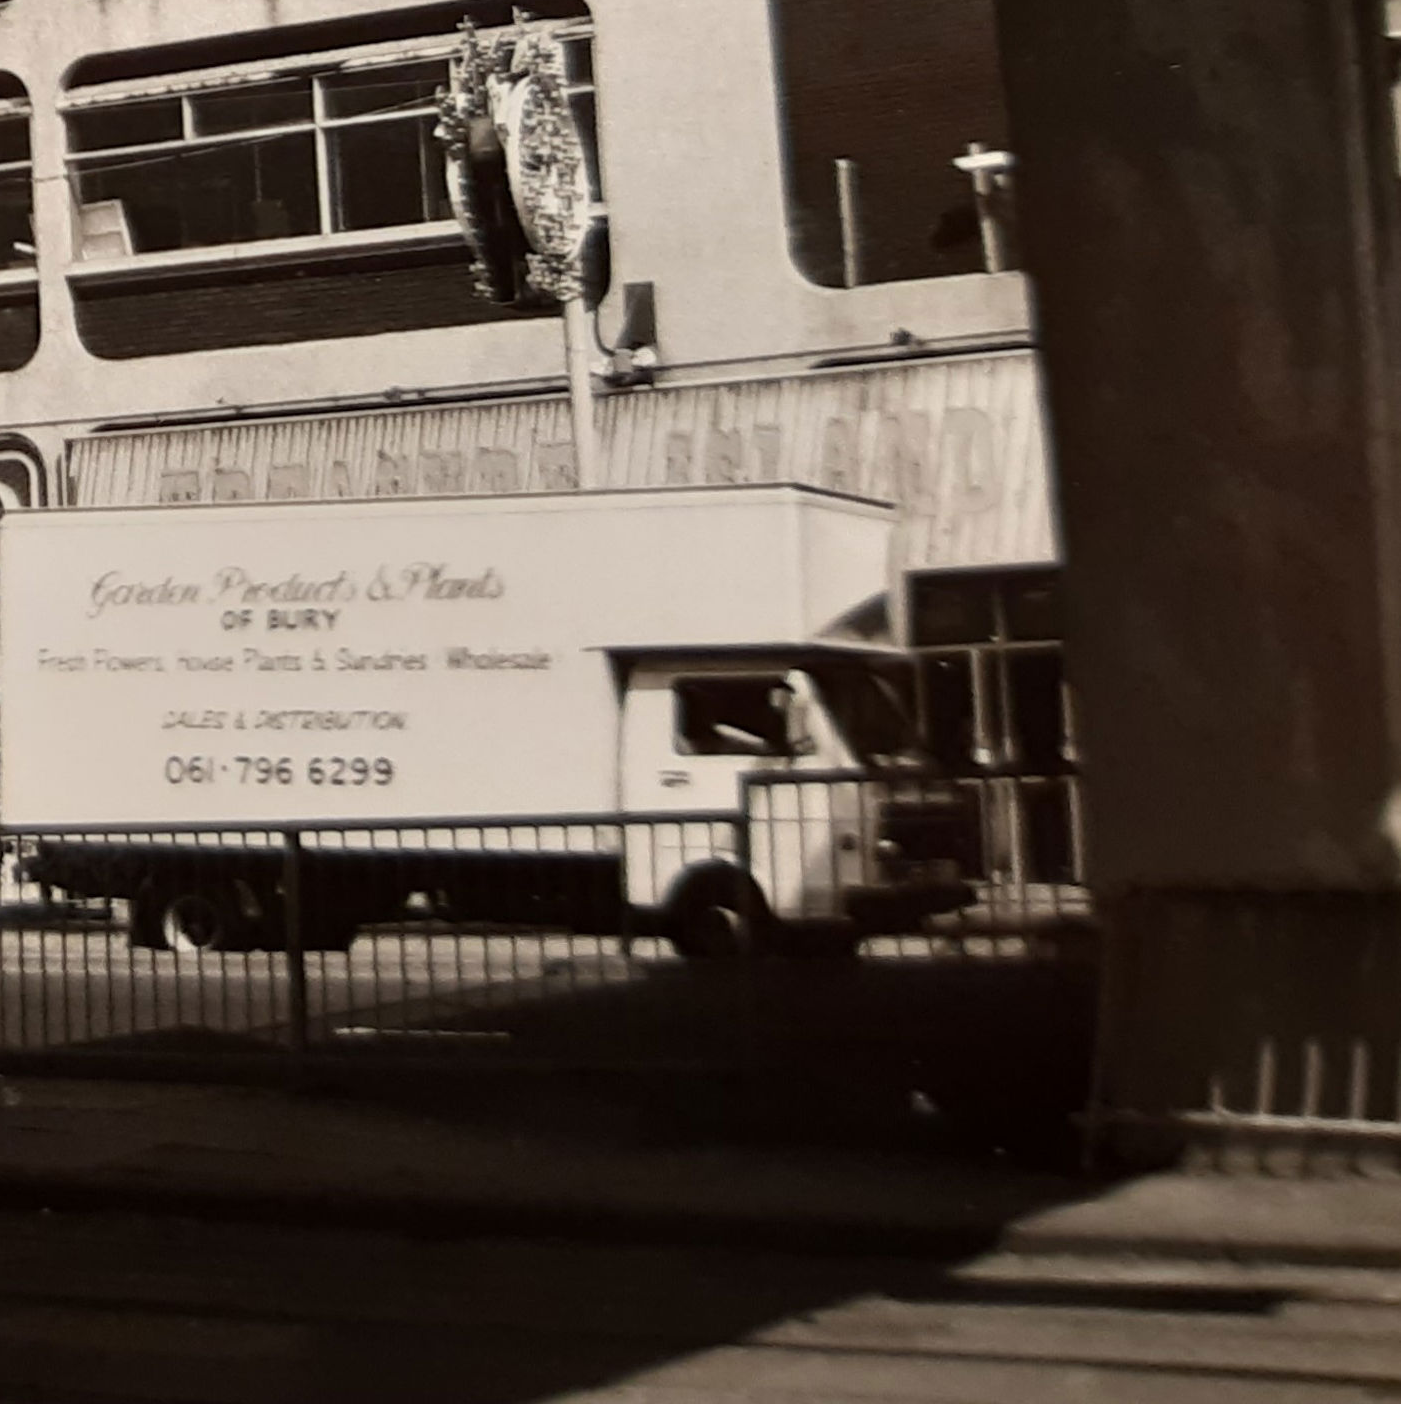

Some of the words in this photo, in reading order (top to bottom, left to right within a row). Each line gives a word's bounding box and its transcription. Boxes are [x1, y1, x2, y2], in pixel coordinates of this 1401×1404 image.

[85, 570, 200, 619] Garden
[207, 566, 357, 603] Products
[403, 562, 505, 600] Plants
[221, 608, 253, 630] OF
[267, 607, 341, 630] BURY
[307, 756, 395, 786] 6299
